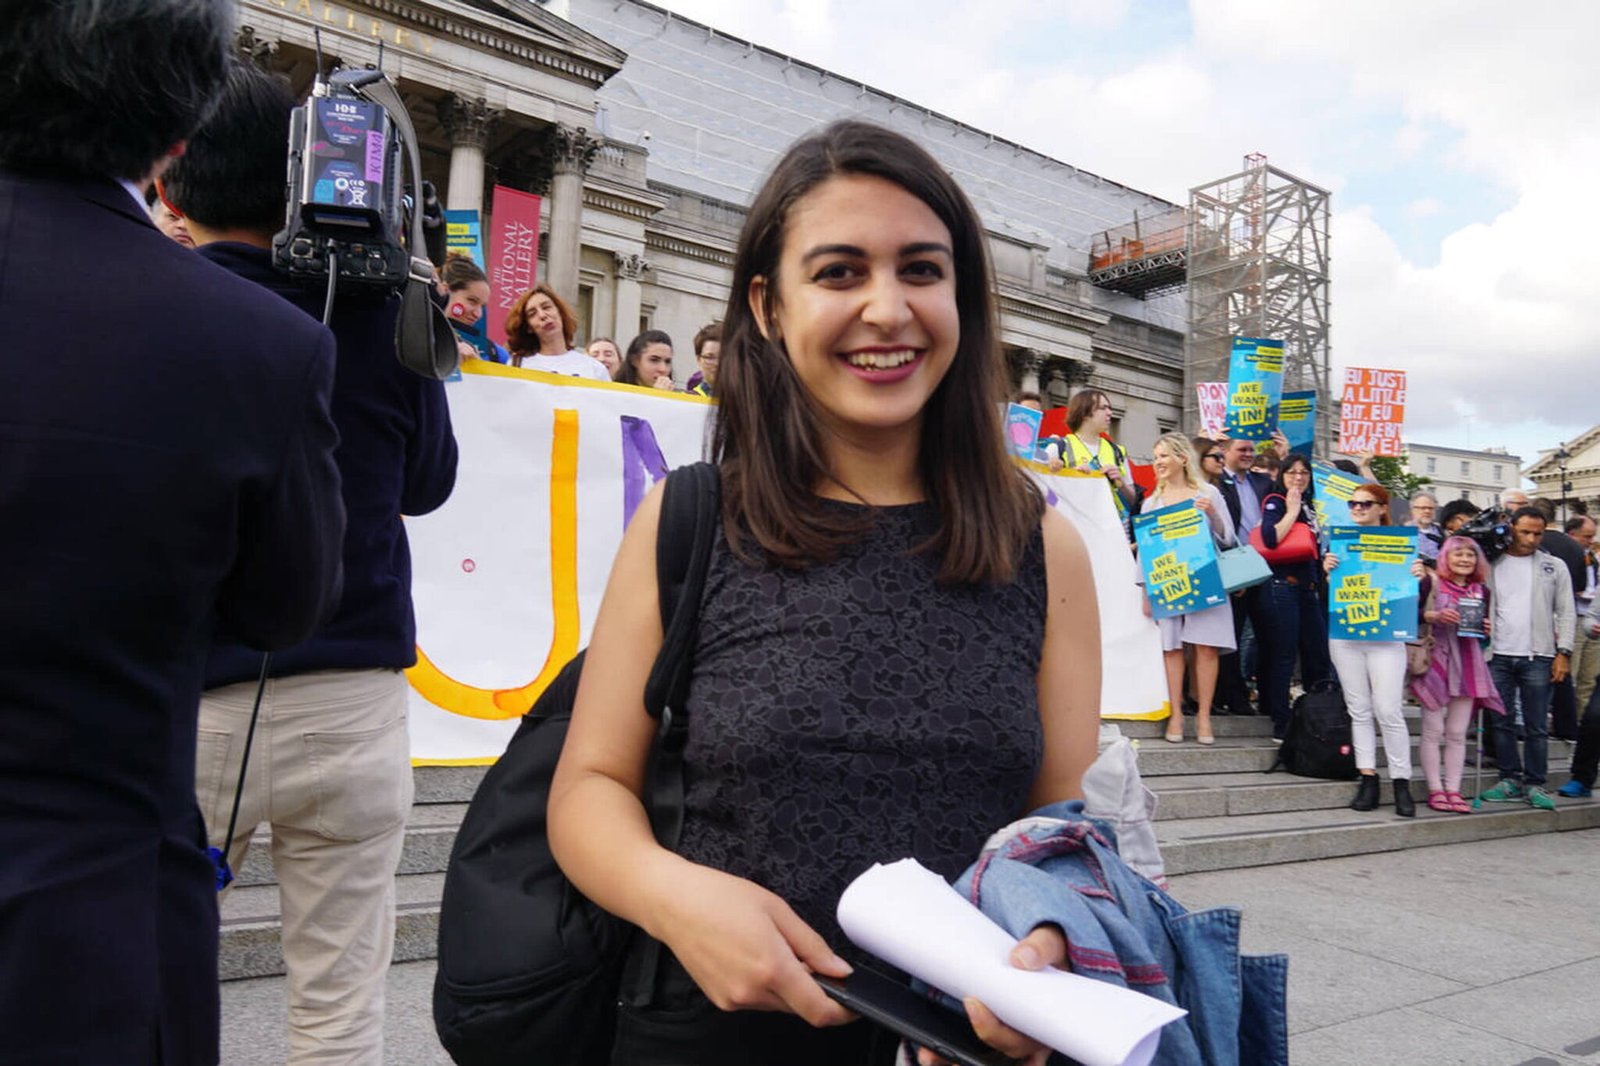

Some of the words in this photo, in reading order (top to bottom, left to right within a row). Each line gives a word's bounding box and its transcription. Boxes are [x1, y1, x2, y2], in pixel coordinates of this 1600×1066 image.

[499, 221, 518, 309] NATIONAL
[513, 223, 534, 304] ALLERY
[1368, 370, 1406, 390] JUST
[1240, 384, 1260, 393] WE
[1344, 386, 1355, 402] A
[1358, 387, 1408, 405] LITTLE
[1233, 395, 1266, 404] WANT
[1242, 408, 1263, 422] IN!
[1371, 404, 1392, 420] EU
[1154, 554, 1174, 568] WE
[1151, 565, 1184, 582] WANT
[1165, 579, 1187, 597] IN!
[1345, 576, 1367, 587] WE
[1338, 590, 1377, 599] WANT
[1351, 604, 1376, 619] IN!
